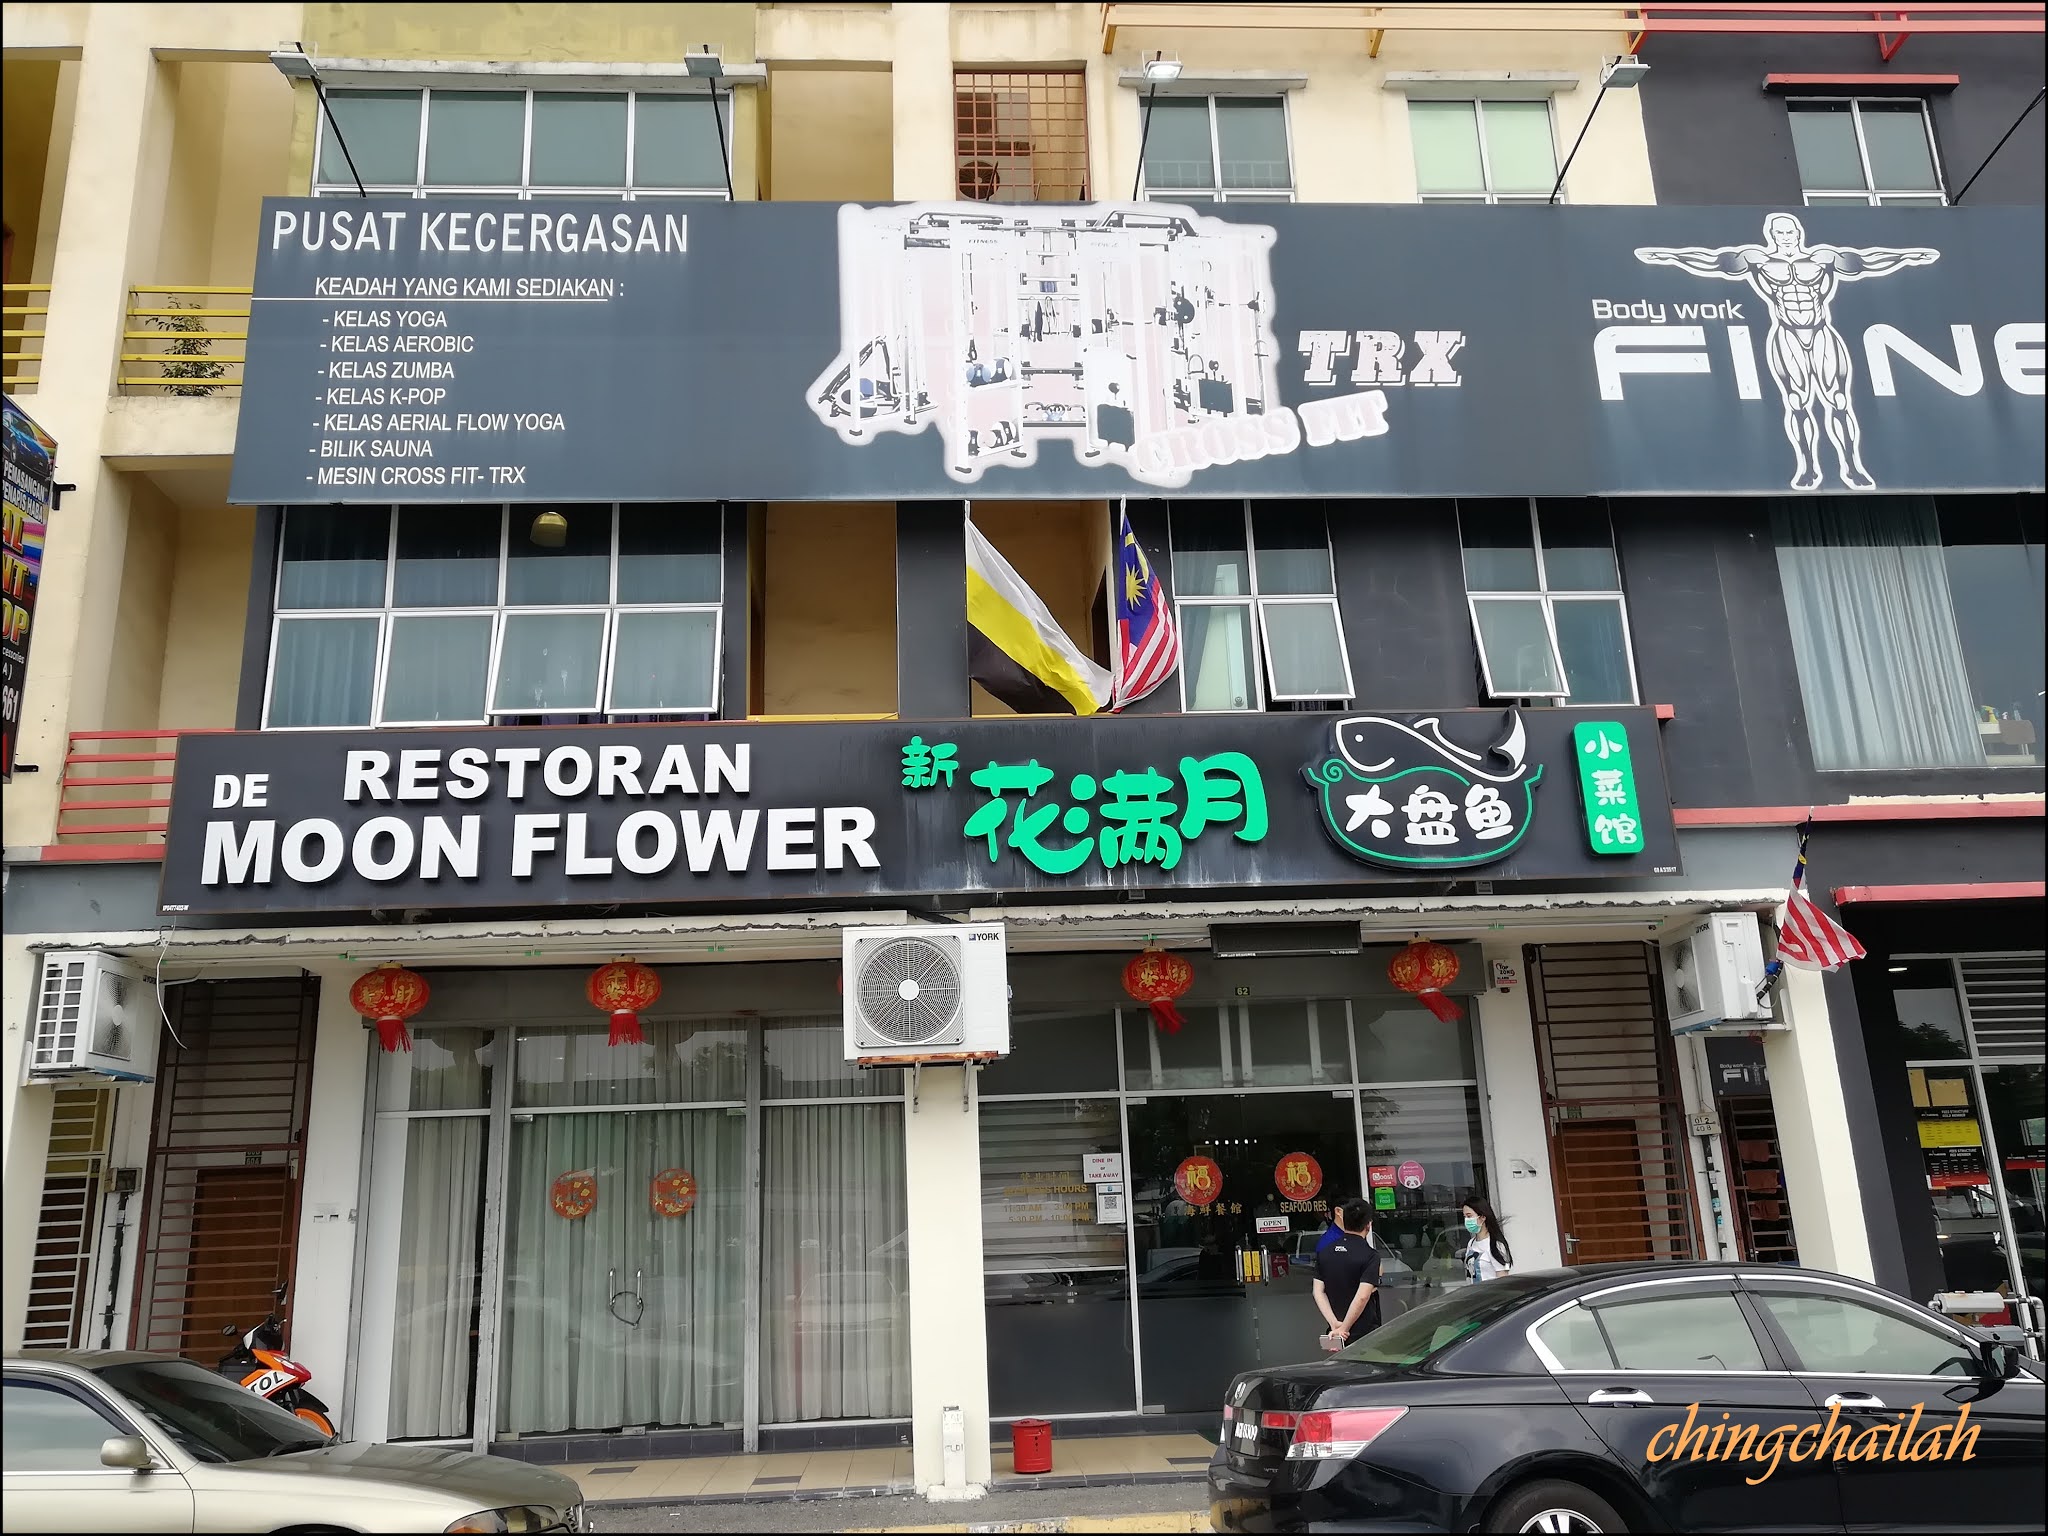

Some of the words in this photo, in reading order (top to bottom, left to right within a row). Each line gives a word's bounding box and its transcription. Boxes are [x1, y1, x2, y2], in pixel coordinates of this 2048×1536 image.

[273, 211, 406, 251] PUSAT
[420, 213, 687, 253] KECERGASAN
[315, 277, 396, 296] KEADAH
[402, 278, 457, 296] YANG
[463, 278, 510, 296] KAMI
[516, 278, 613, 297] SEDIAKAN
[334, 311, 391, 327] KELAS
[396, 311, 447, 327] YOGA
[1592, 299, 1666, 323] Body
[1673, 299, 1745, 319] work
[331, 336, 389, 352] KELAS
[393, 336, 474, 352] AEROBIC
[1298, 331, 1466, 387] TRX
[329, 362, 387, 378] KELAS
[391, 362, 454, 379] ZUMBA
[327, 388, 385, 405] KELAS
[390, 388, 446, 405] K-POP
[324, 414, 382, 431] KELAS
[387, 414, 451, 431] AERIAL
[457, 414, 510, 431] FLOW
[513, 413, 565, 431] YOGA
[321, 440, 366, 457] BILIK
[370, 440, 433, 457] SAUNA
[3, 459, 45, 503] PEMASANGAN
[318, 467, 376, 484] MESIN
[381, 467, 445, 484] CROSS
[489, 466, 525, 483] TRX
[344, 743, 750, 800] RESTORAN
[212, 774, 269, 808] DE
[1584, 730, 1638, 845] 小菜馆
[902, 736, 960, 789] 新
[964, 752, 1269, 874] 花满月
[1345, 784, 1514, 846] 大盘鱼
[201, 814, 481, 885] MOON
[511, 807, 881, 878] FLOWER
[977, 932, 1000, 941] YORK
[1236, 987, 1249, 996] 62
[1053, 1184, 1088, 1193] HOURS
[1074, 1201, 1089, 1210] PM
[1280, 1201, 1312, 1213] SEAFOOD
[1263, 1219, 1282, 1227] OPEN
